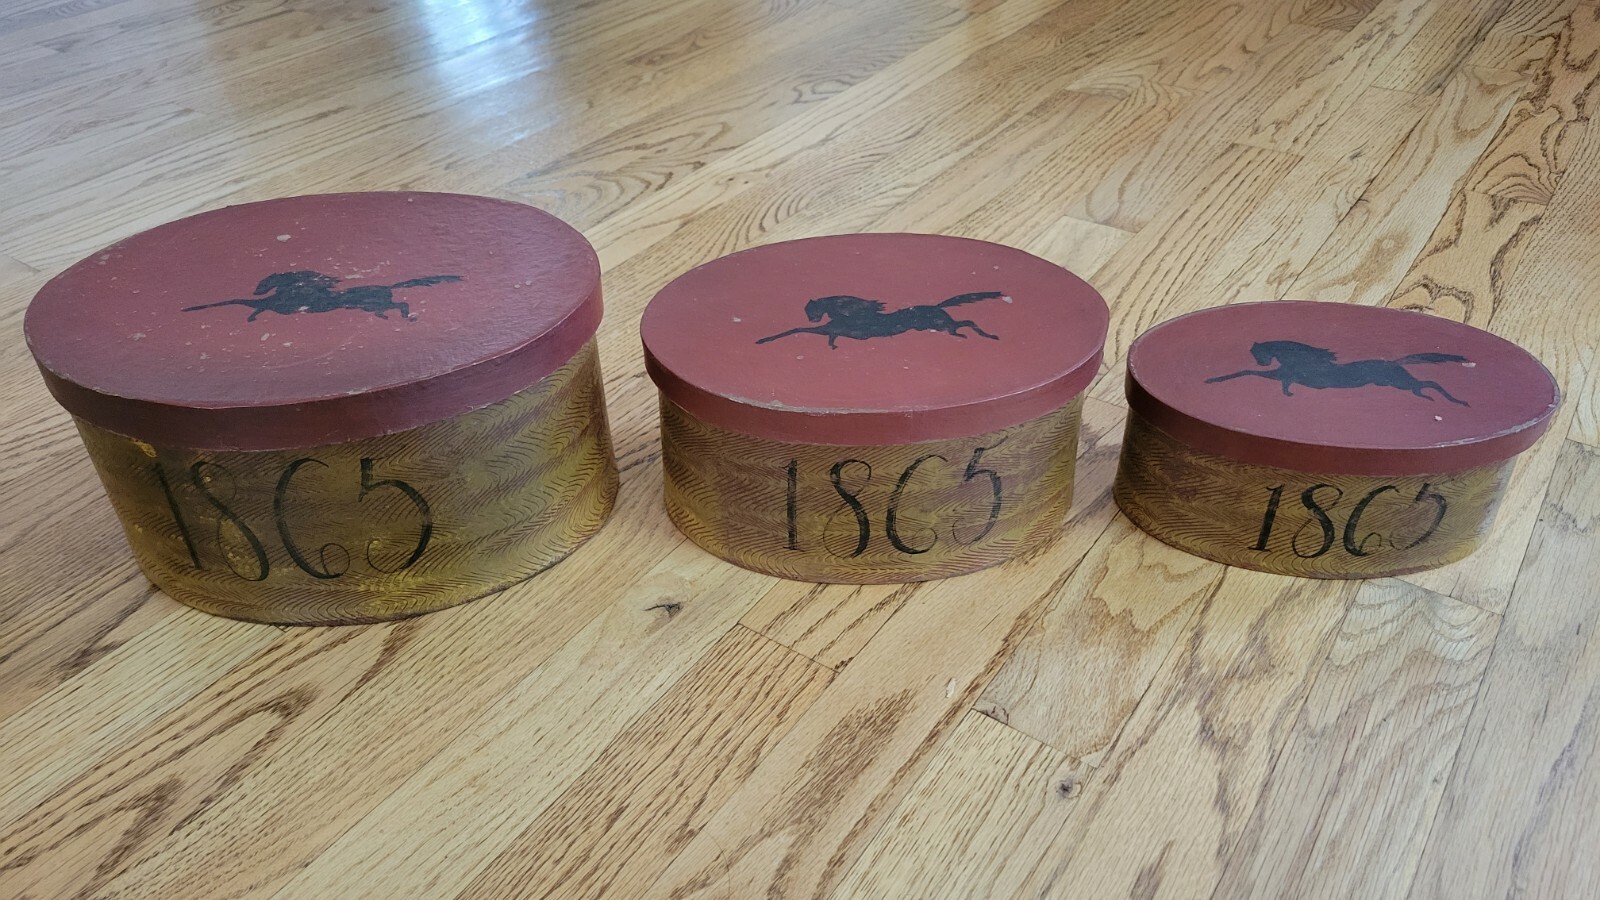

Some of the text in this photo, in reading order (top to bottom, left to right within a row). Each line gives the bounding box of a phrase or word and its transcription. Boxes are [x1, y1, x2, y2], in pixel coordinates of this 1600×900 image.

[154, 456, 433, 582] 1865
[782, 434, 1009, 559] 1865
[1247, 482, 1448, 559] 1865
